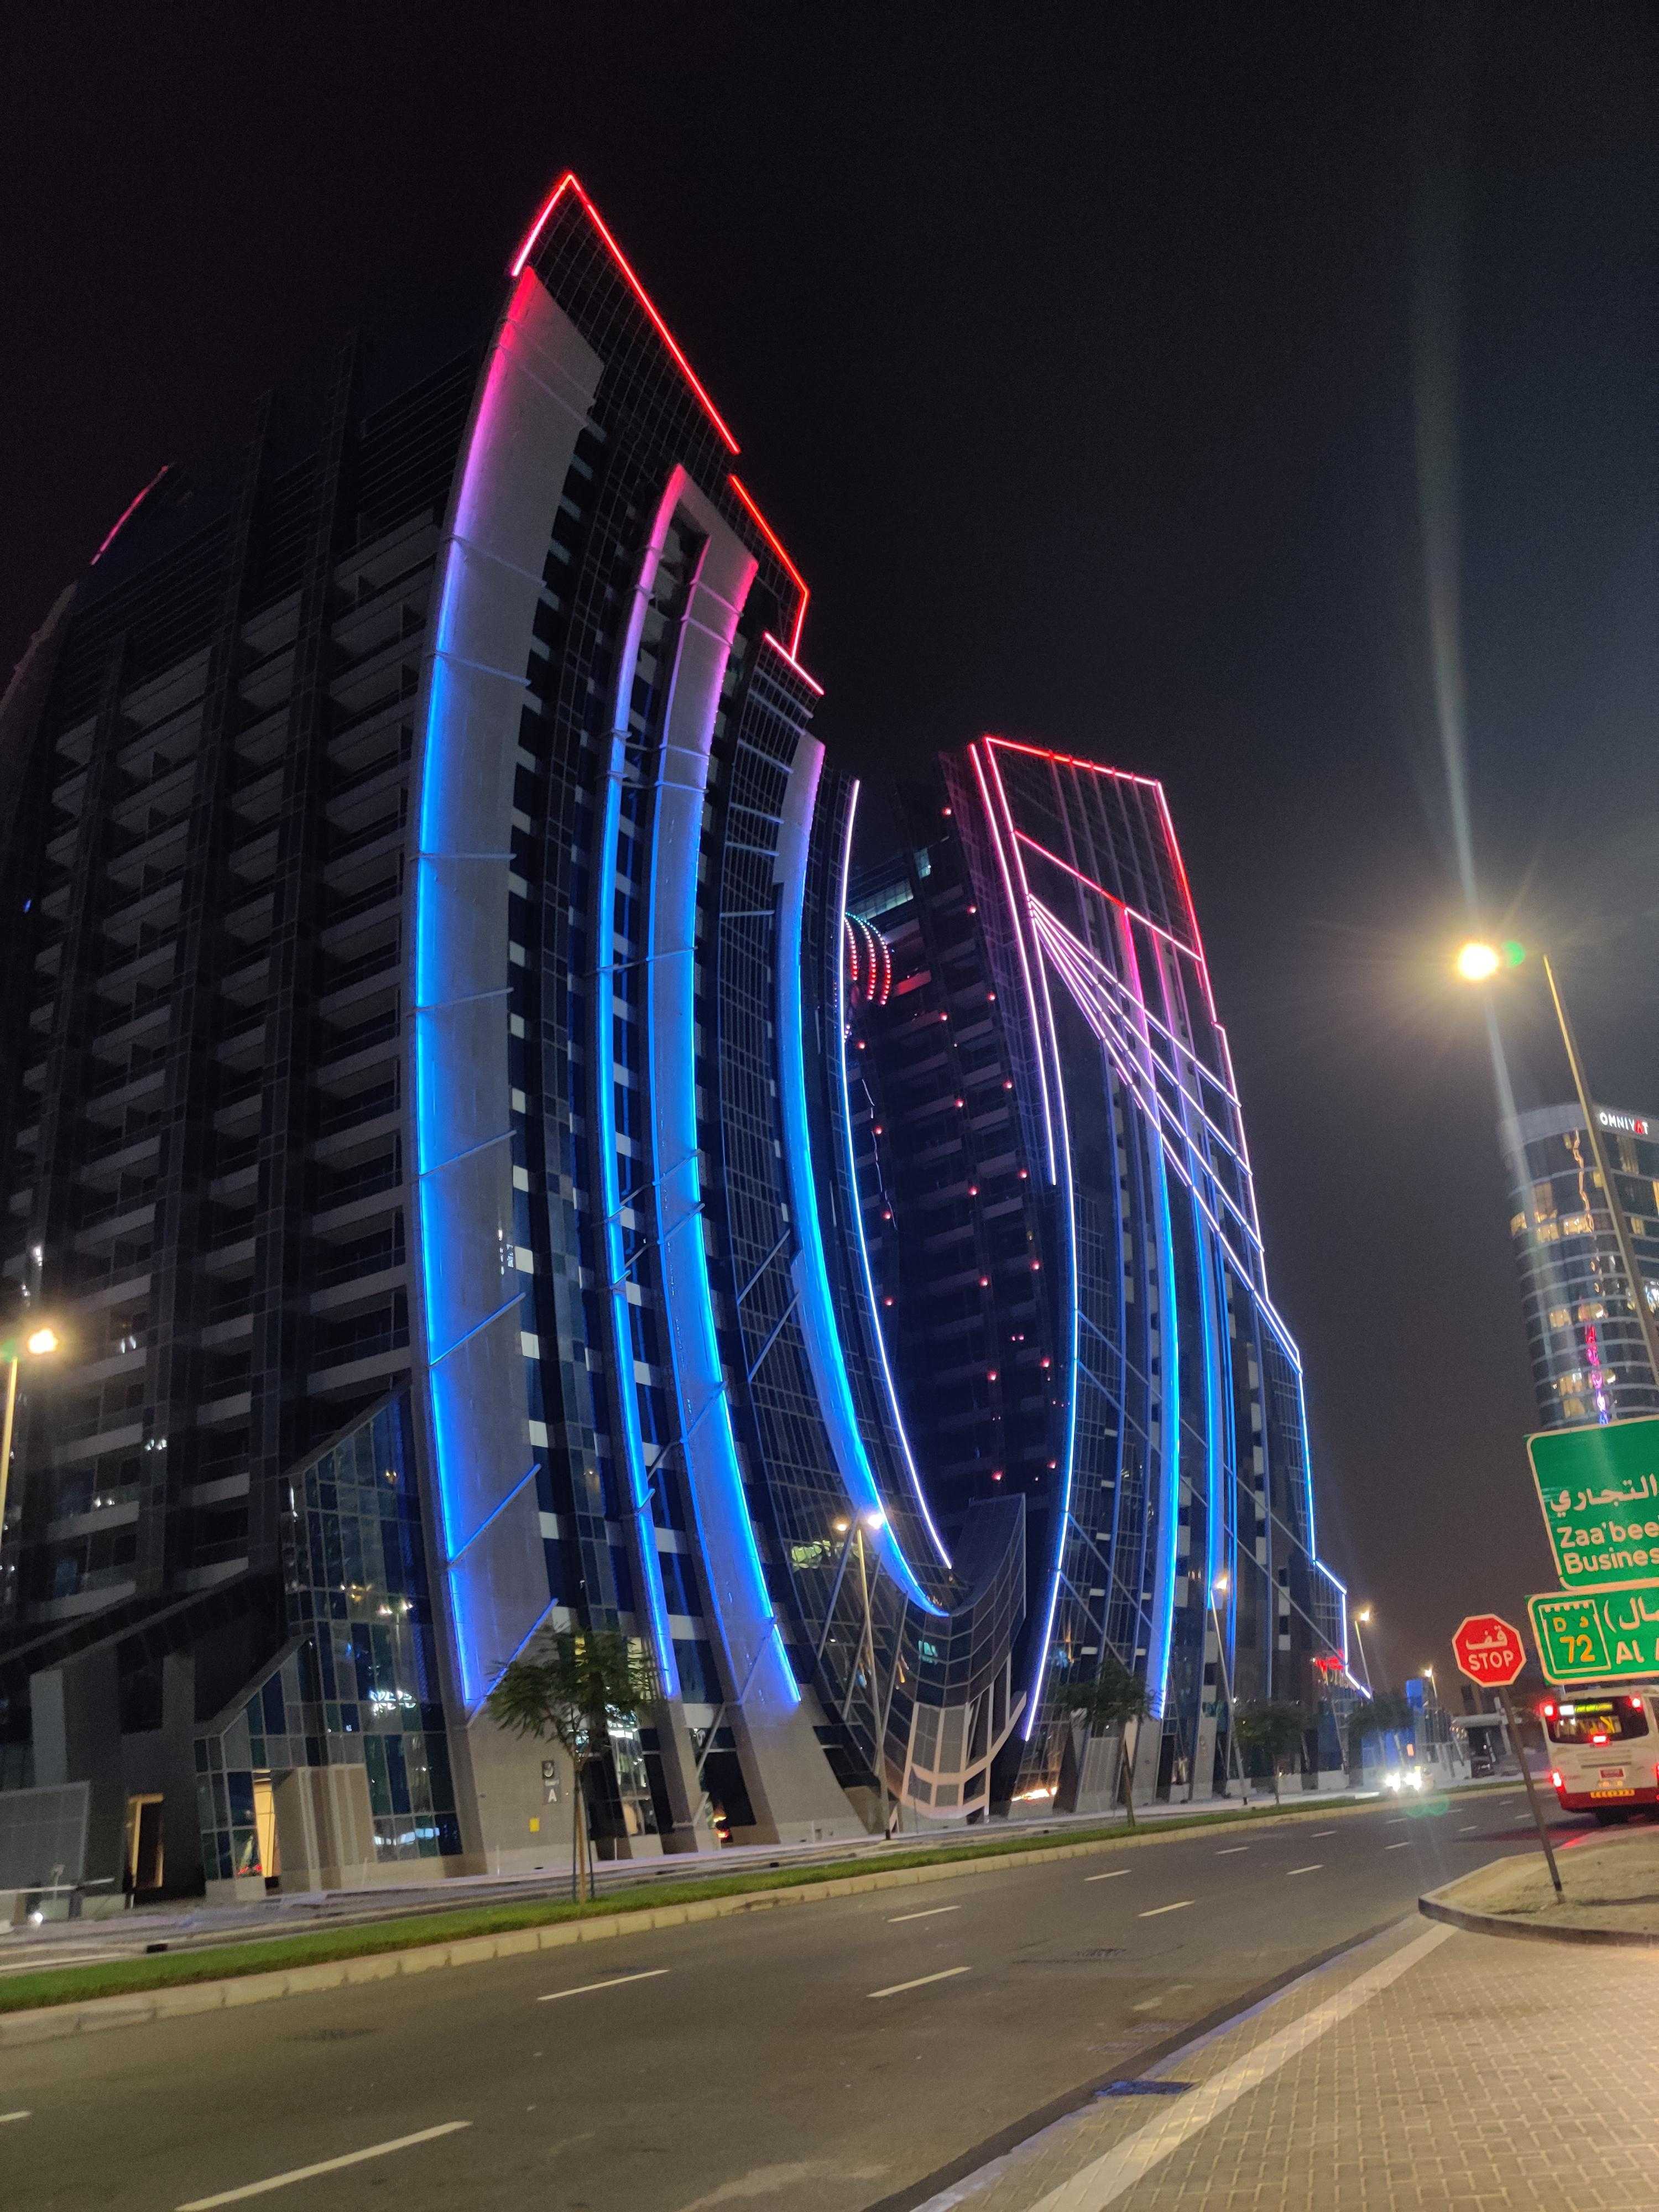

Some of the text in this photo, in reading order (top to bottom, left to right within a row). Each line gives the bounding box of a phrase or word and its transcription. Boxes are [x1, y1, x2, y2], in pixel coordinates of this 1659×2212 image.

[1599, 1112, 1649, 1135] OMNIYAT
[1550, 1473, 1658, 1518] التجاري
[1557, 1521, 1659, 1548] Zaa'bee
[1553, 1616, 1567, 1632] D
[1465, 1625, 1509, 1650] قف
[1559, 1634, 1596, 1664] 72
[1468, 1650, 1514, 1671] STOP
[1616, 1640, 1645, 1665] Al
